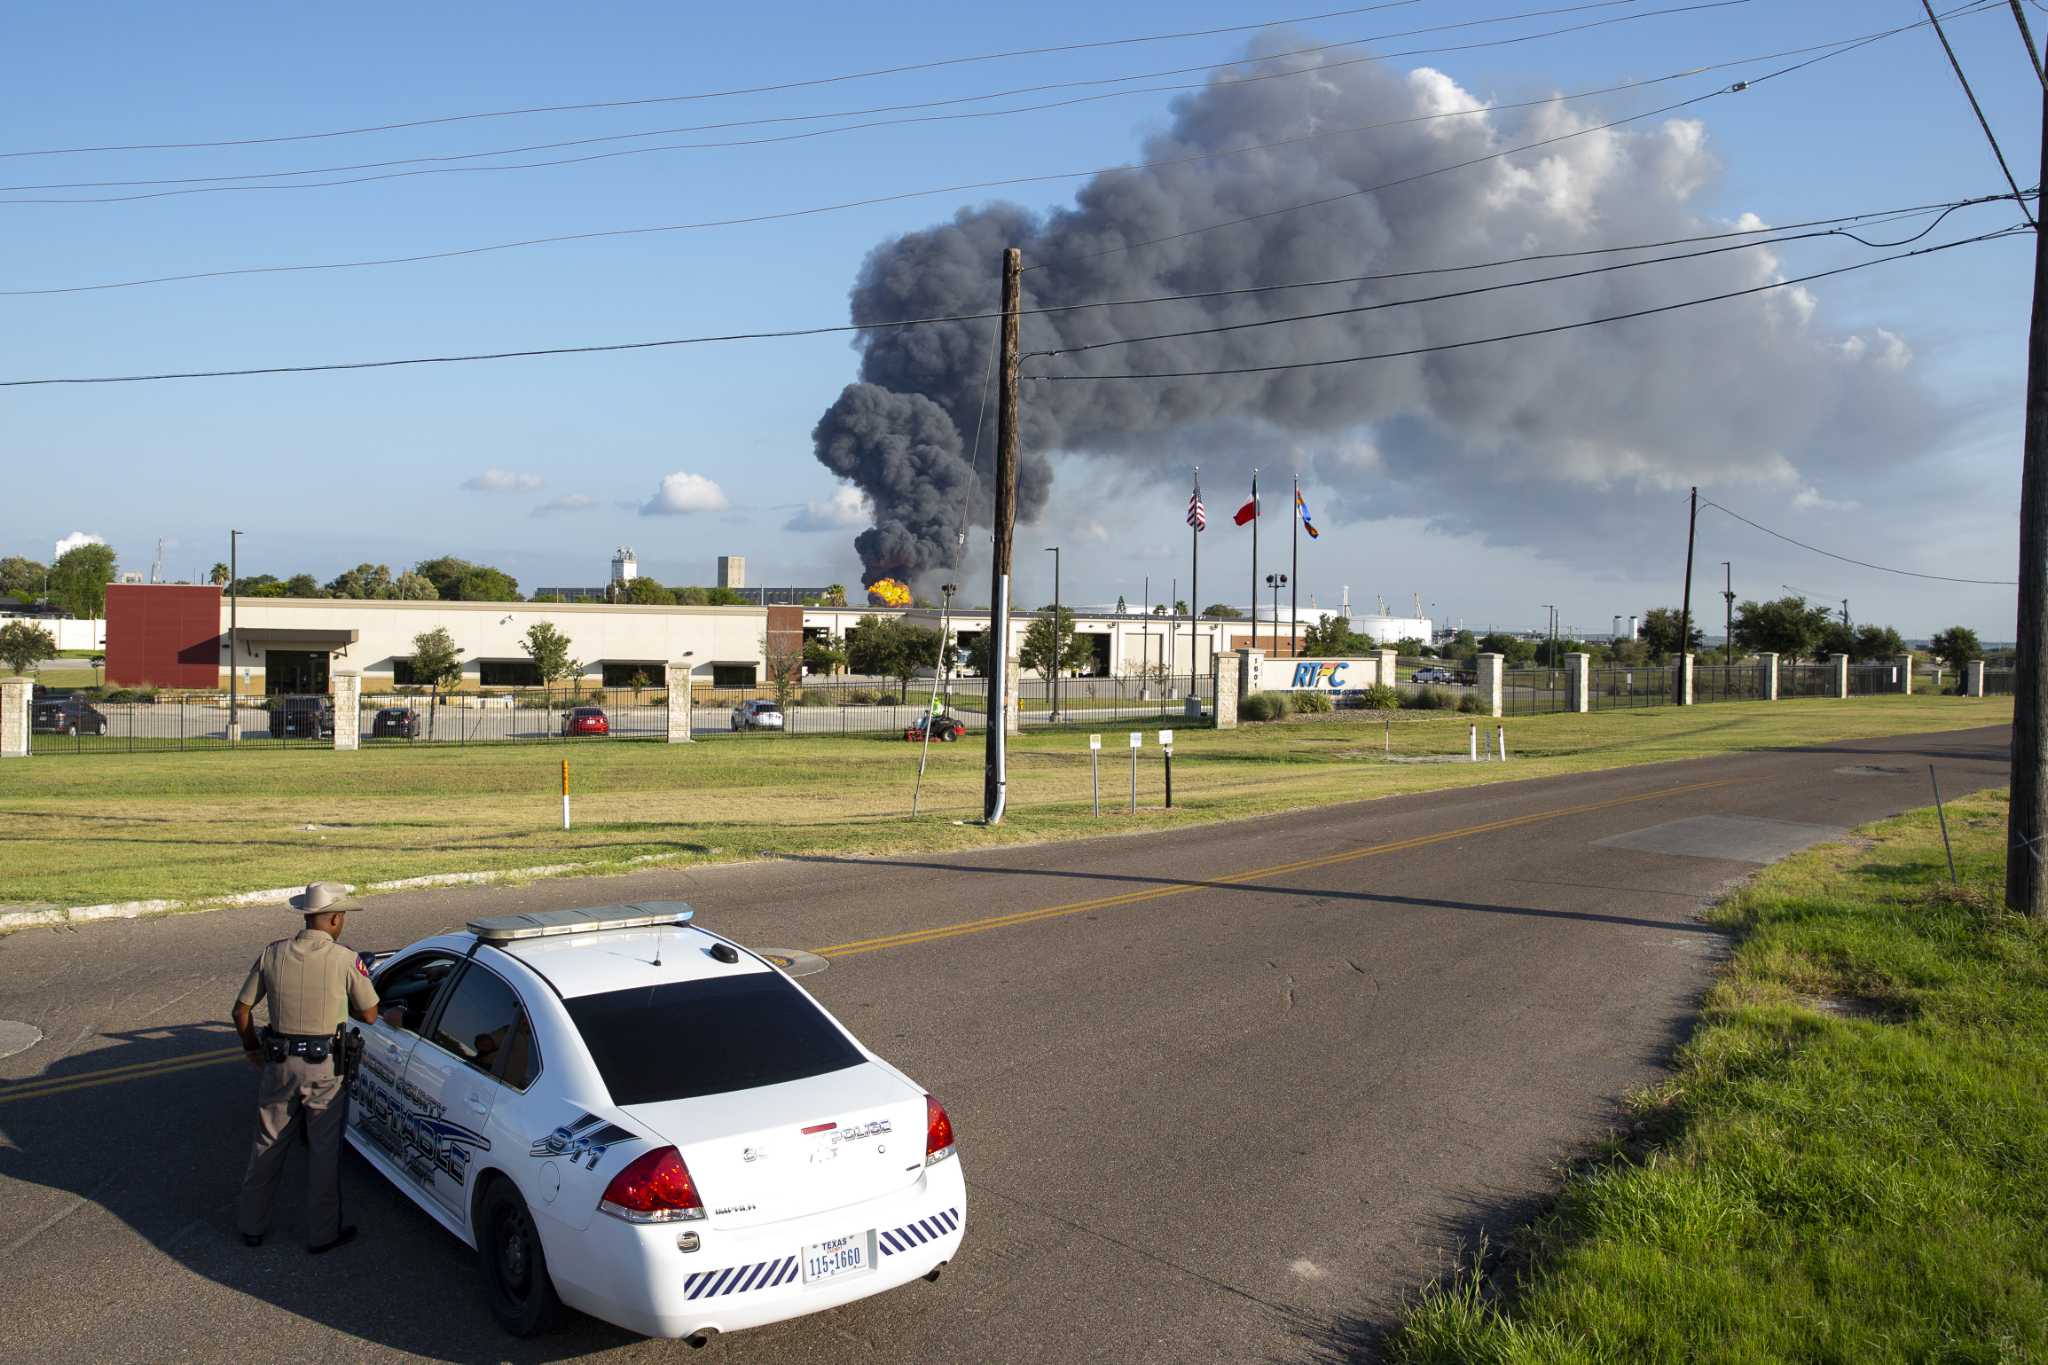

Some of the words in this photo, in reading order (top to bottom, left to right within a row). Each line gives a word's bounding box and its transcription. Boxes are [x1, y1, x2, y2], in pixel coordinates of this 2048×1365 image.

[1291, 661, 1349, 688] RTFC
[546, 1125, 609, 1171] 911
[821, 1237, 848, 1251] TEXAS
